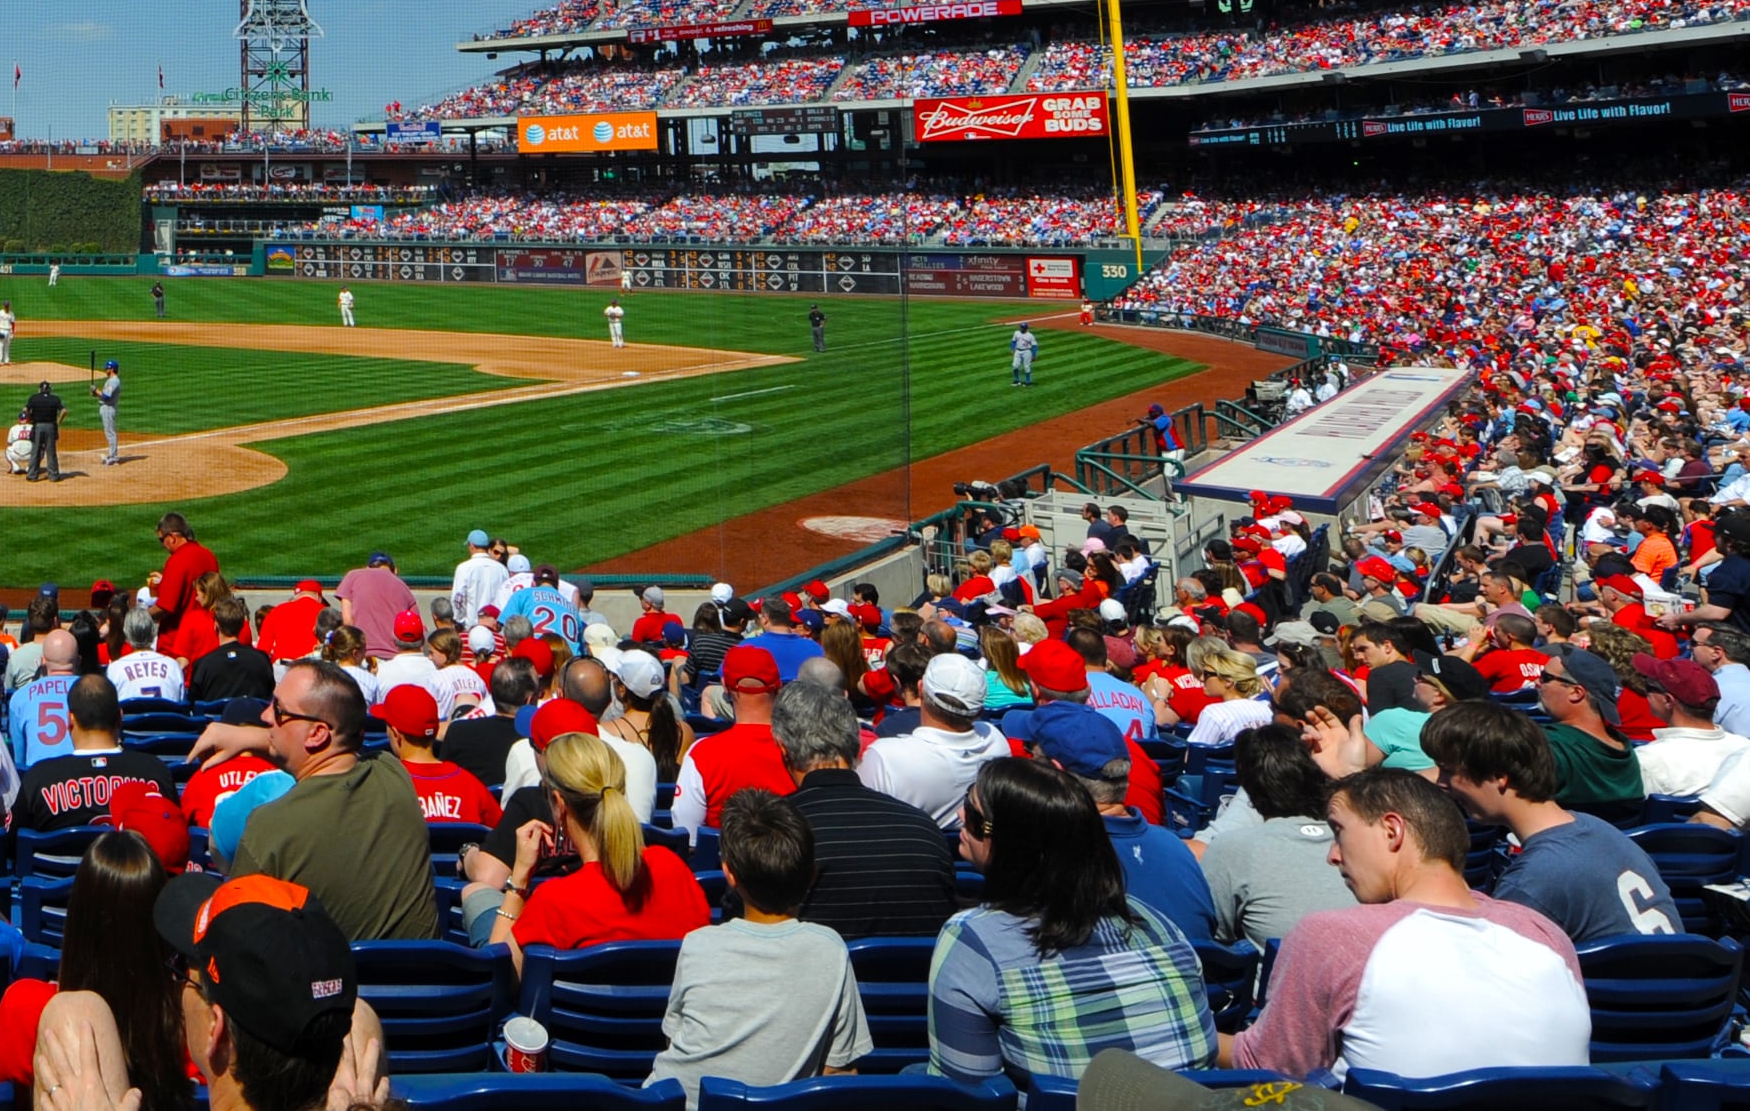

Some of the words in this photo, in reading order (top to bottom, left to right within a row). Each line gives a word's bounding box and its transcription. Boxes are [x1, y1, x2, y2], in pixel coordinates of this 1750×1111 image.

[713, 23, 753, 35] refreshing
[225, 88, 286, 102] Citizens
[292, 88, 332, 102] Bank
[260, 105, 294, 119] Park
[1043, 97, 1100, 111] GRAB
[1554, 109, 1575, 121] Live
[1578, 107, 1599, 120] Life
[1601, 105, 1626, 118] with
[1629, 102, 1671, 116] Flavor!
[920, 110, 1034, 129] Budweiser
[1053, 110, 1091, 119] SOME
[548, 125, 579, 141] at&t
[617, 124, 650, 139] at&t
[1045, 118, 1102, 132] BUDS
[1388, 121, 1405, 133] Live
[1407, 120, 1424, 132] Life
[1426, 119, 1444, 130] with
[1448, 116, 1480, 128] Flavor!
[1102, 265, 1127, 278] 330
[533, 606, 578, 642] 20
[123, 661, 168, 681] REYES
[29, 680, 70, 701] PAPEL
[1086, 692, 1145, 716] ALLADAY
[41, 776, 160, 815] VICTO
[417, 791, 461, 820] BAÑEZ
